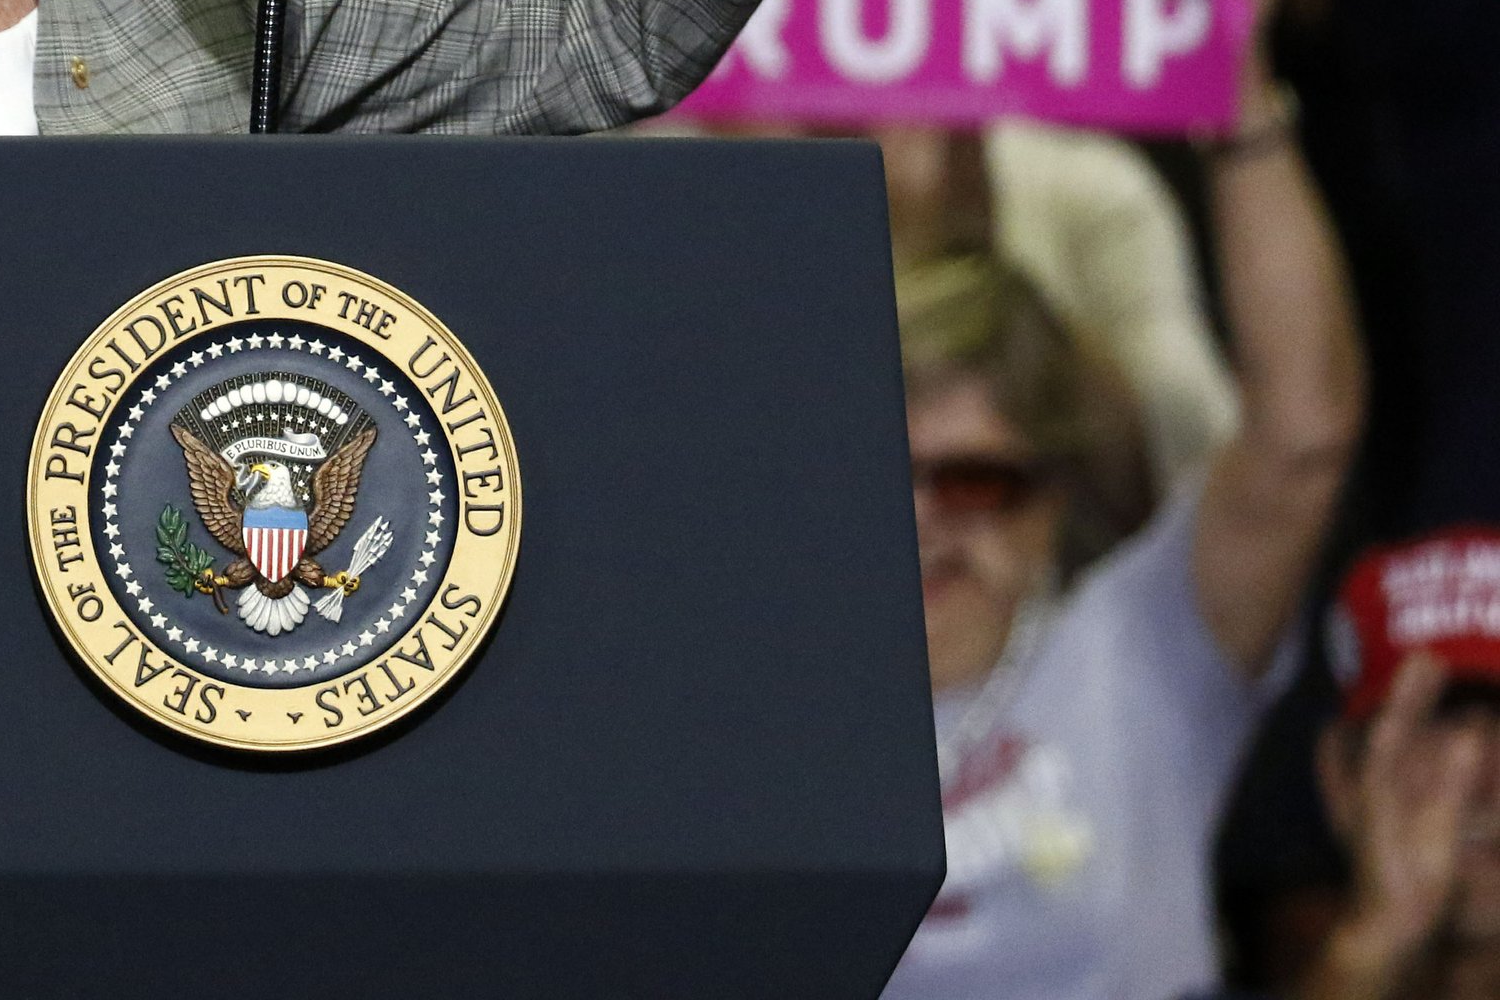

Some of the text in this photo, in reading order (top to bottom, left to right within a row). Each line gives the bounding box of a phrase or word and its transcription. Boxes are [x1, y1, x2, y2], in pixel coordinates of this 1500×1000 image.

[45, 273, 505, 729] SEAL OF THE PRESIDENT OF THE UNITED STATES
[226, 439, 322, 460] E PLURIBUS UNUM
